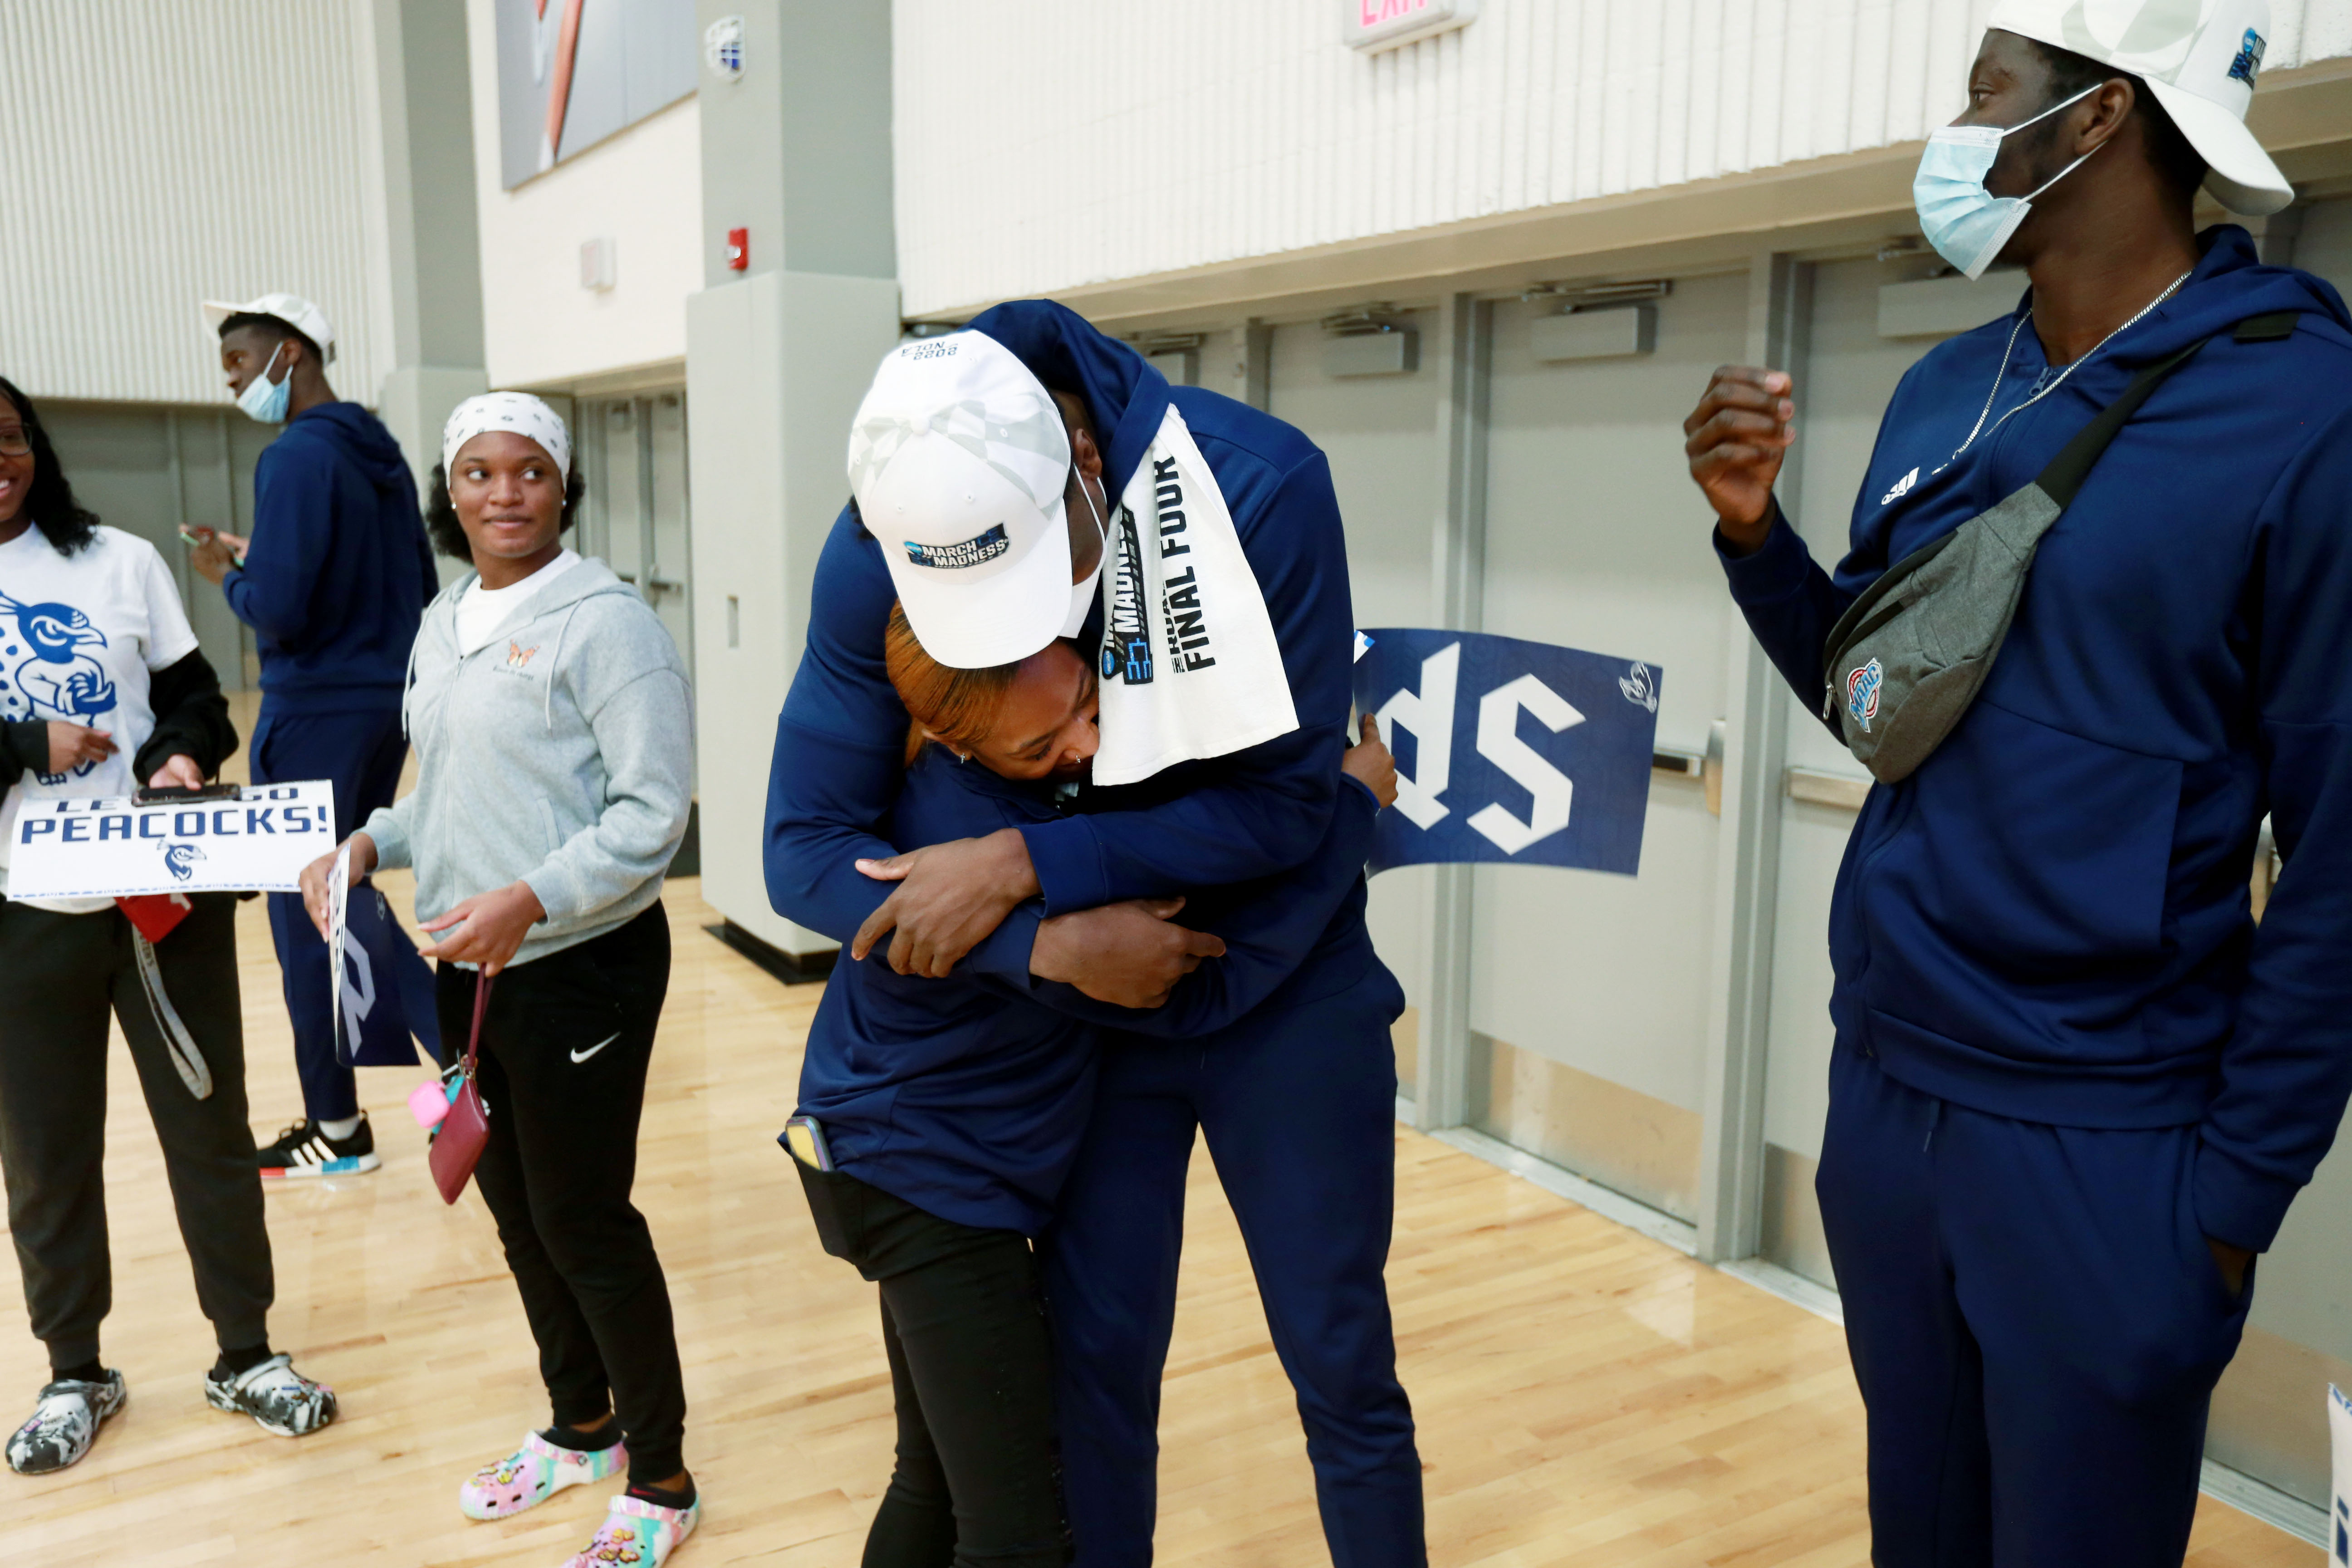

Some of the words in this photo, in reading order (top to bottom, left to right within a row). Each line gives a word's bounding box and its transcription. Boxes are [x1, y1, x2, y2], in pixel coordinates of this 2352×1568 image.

[913, 347, 957, 360] 2022
[1154, 456, 1190, 559] FOUR
[922, 540, 976, 557] MARCH
[933, 539, 1005, 566] MADNESS
[1166, 566, 1215, 671] FINAL
[1171, 657, 1185, 675] TH
[1851, 664, 1880, 728] MAAC
[21, 806, 328, 844] PEACOCKS!
